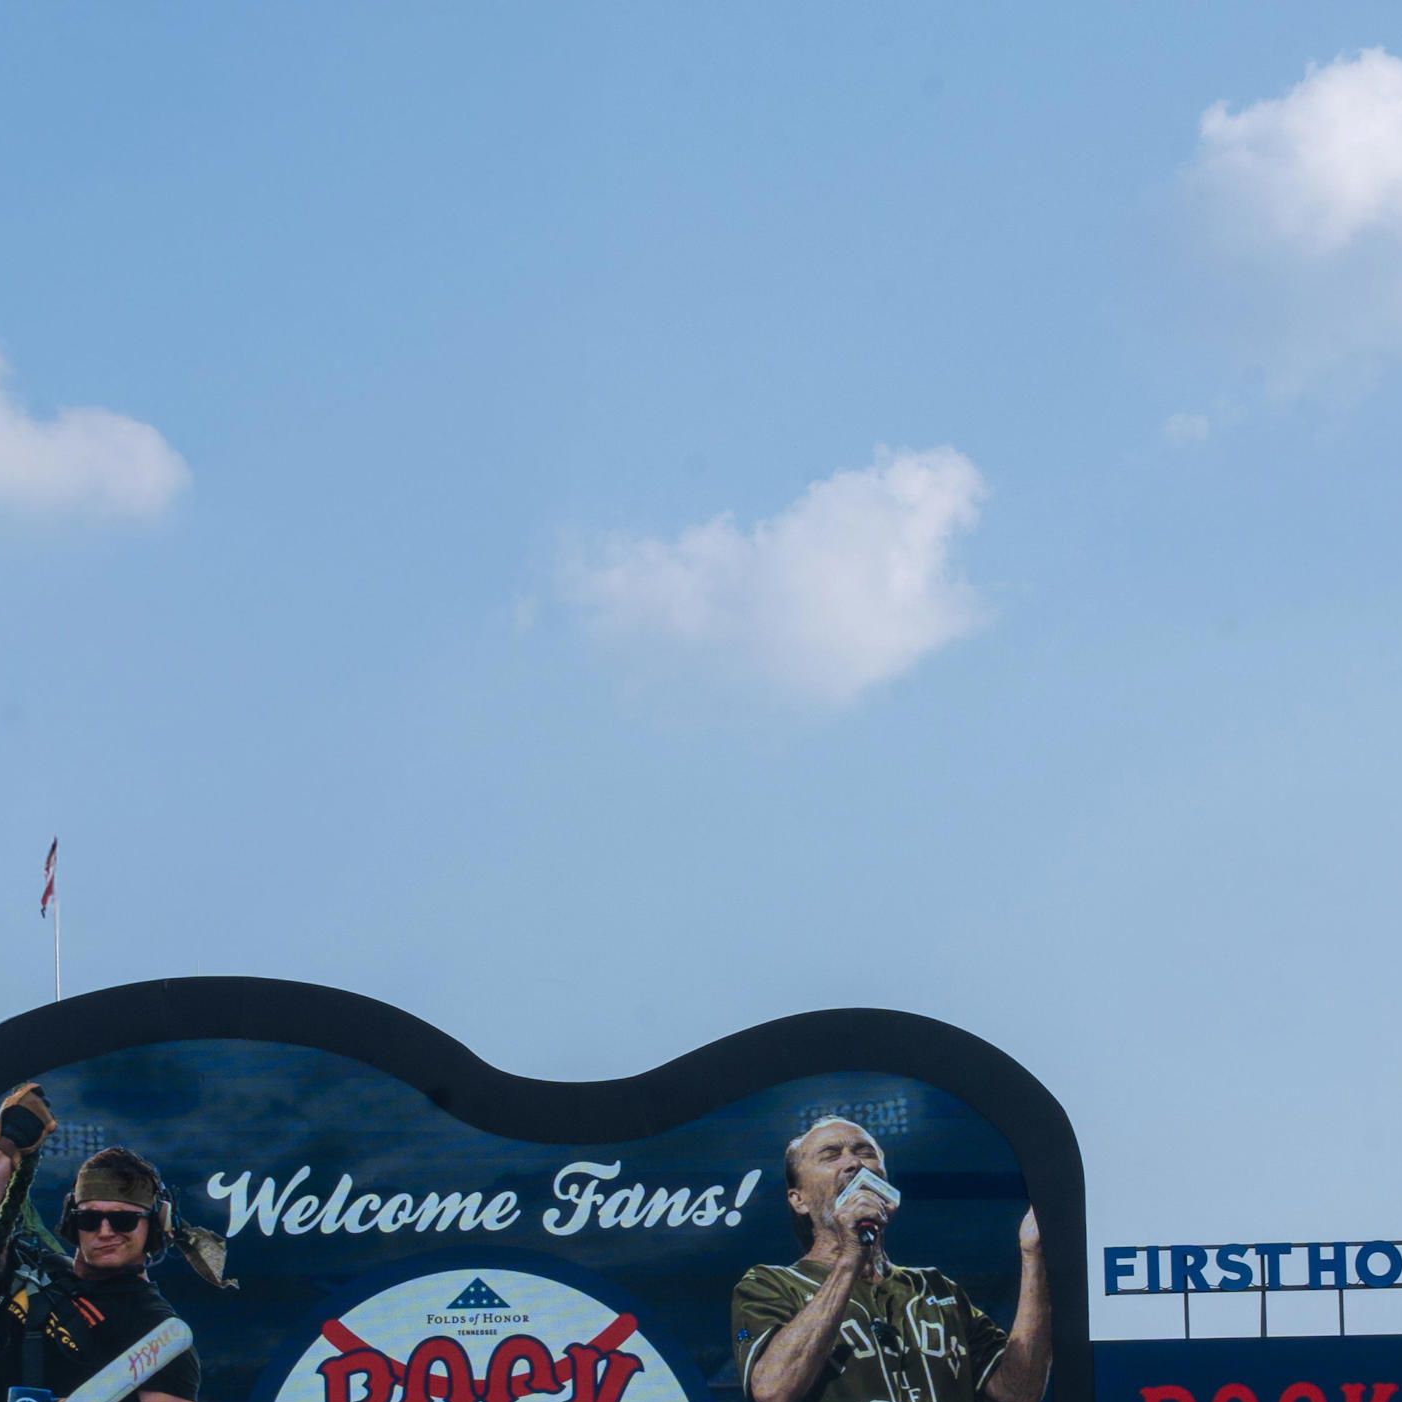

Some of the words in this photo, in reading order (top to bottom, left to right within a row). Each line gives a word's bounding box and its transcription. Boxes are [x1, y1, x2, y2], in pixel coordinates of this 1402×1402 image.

[206, 1165, 521, 1238] Welcome
[542, 1159, 762, 1236] Fans!
[1104, 1243, 1291, 1294] FIRST
[457, 1328, 498, 1336] TENNESSEE
[469, 1312, 480, 1325] of
